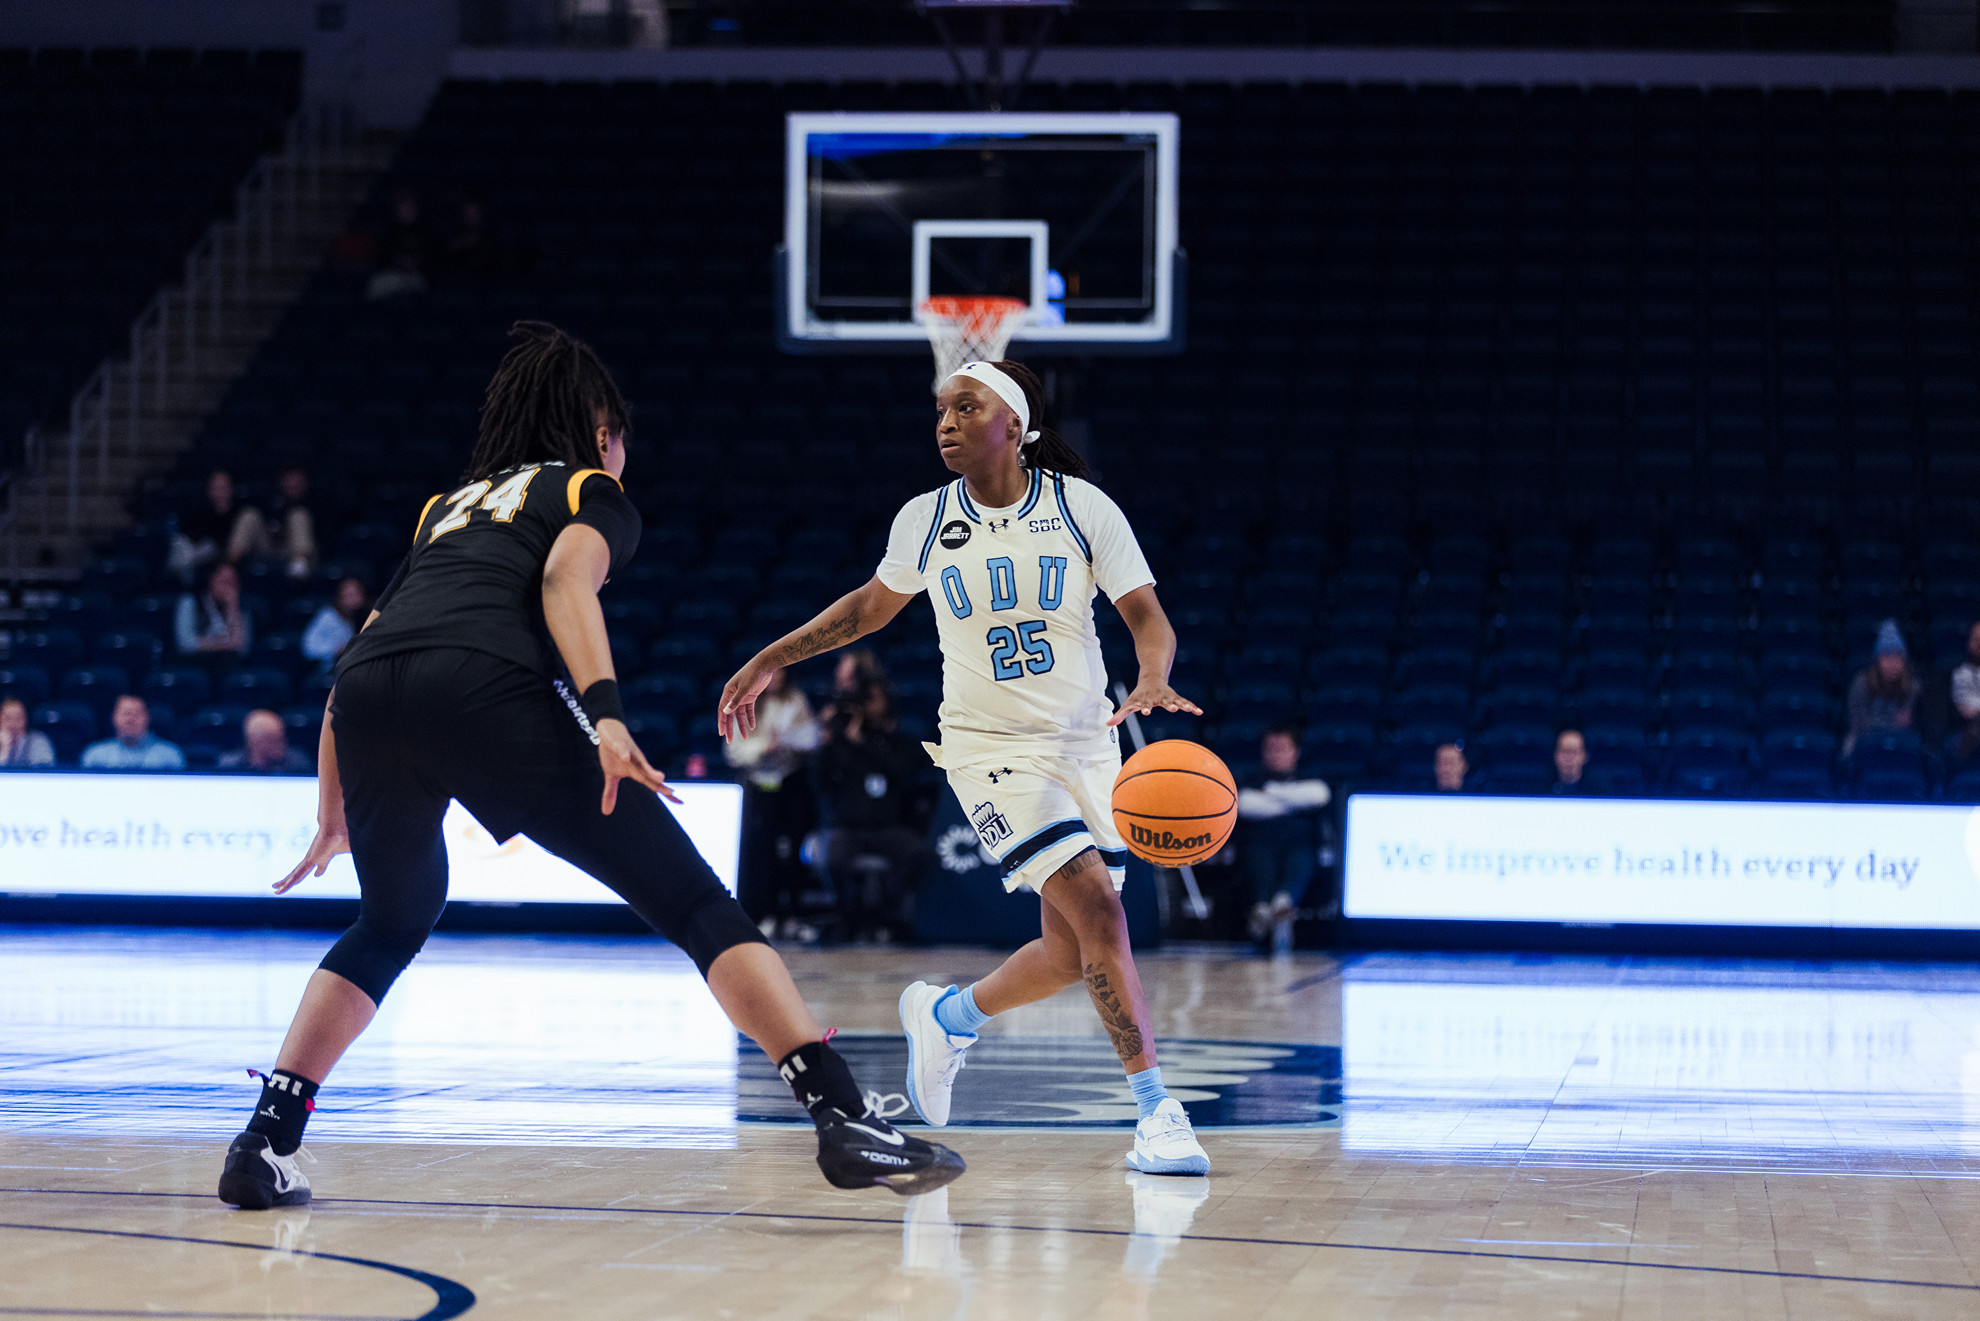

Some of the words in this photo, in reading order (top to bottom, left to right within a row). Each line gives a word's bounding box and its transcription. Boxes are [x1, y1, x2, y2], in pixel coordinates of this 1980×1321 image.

[429, 467, 541, 543] 24
[1029, 517, 1062, 533] SBC
[941, 556, 1067, 620] ODU
[986, 619, 1055, 681] 25
[60, 817, 172, 850] health
[182, 827, 276, 861] every
[1129, 822, 1212, 850] Wilson
[1379, 842, 1434, 873] We
[1444, 842, 1601, 882] improve
[1612, 845, 1733, 878] health
[1742, 853, 1846, 890] every
[1854, 848, 1921, 892] day
